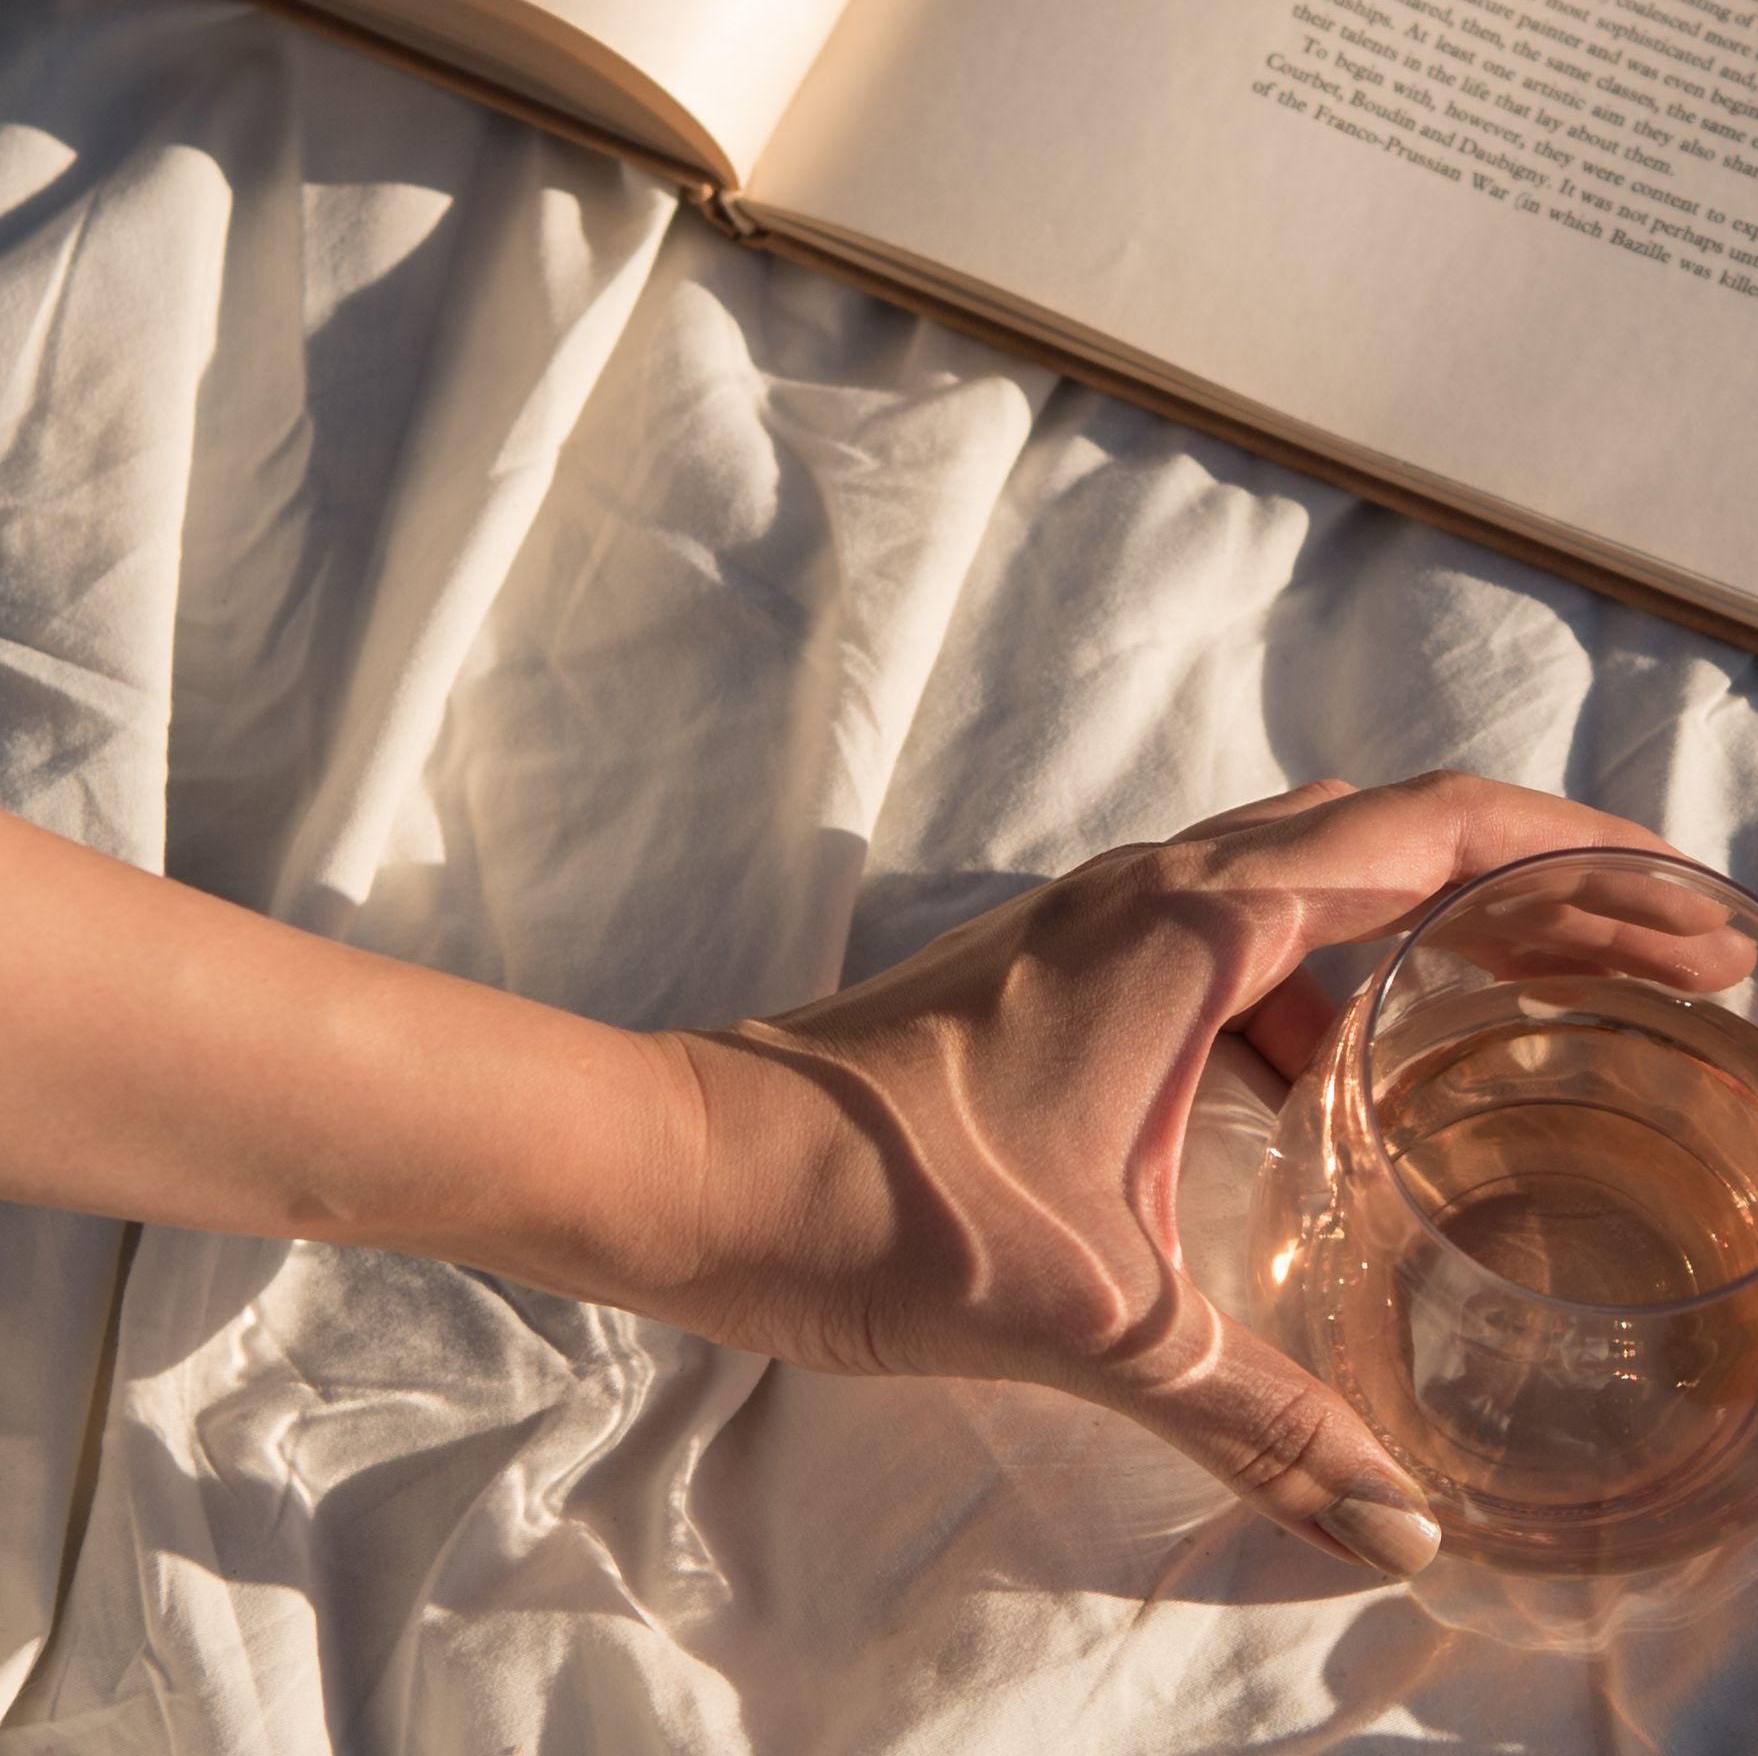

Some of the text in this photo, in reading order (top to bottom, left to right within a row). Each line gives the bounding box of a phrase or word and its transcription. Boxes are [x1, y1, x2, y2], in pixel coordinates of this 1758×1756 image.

[1264, 52, 1344, 103] Courbet,
[1348, 88, 1417, 132] Boudin
[1418, 124, 1458, 149] and
[1456, 136, 1552, 189] Daubigny.
[1557, 177, 1577, 199] It
[1580, 189, 1614, 213] was
[1615, 204, 1650, 227] not
[1648, 217, 1725, 255] perhaps
[1290, 3, 1675, 178] their talents in the life that lay about them.
[1300, 33, 1329, 61] To
[1333, 49, 1385, 87] begin
[1392, 80, 1437, 113] with,
[1443, 99, 1526, 151] however,
[1532, 140, 1575, 169] they
[1581, 160, 1626, 187] were
[1629, 181, 1701, 216] content
[1705, 207, 1727, 225] to
[1403, 21, 1430, 45] At
[1433, 33, 1477, 66] least
[1481, 59, 1517, 82] one
[1521, 76, 1587, 111] artistic
[1589, 104, 1627, 129] aim
[1632, 119, 1674, 148] they
[1677, 137, 1717, 162] also
[1460, 17, 1506, 52] then,
[1511, 40, 1542, 63] the
[1544, 56, 1593, 84] same
[1595, 75, 1661, 115] classes,
[1665, 102, 1697, 125] the
[1699, 117, 1748, 144] same
[1250, 80, 1278, 99] of
[1276, 89, 1308, 114] the
[1312, 103, 1463, 183] Franco-Prussian
[1471, 171, 1510, 202] War
[1513, 191, 1542, 216] (in
[1548, 207, 1604, 240] which
[1608, 227, 1672, 265] Bazille
[1679, 257, 1713, 281] was
